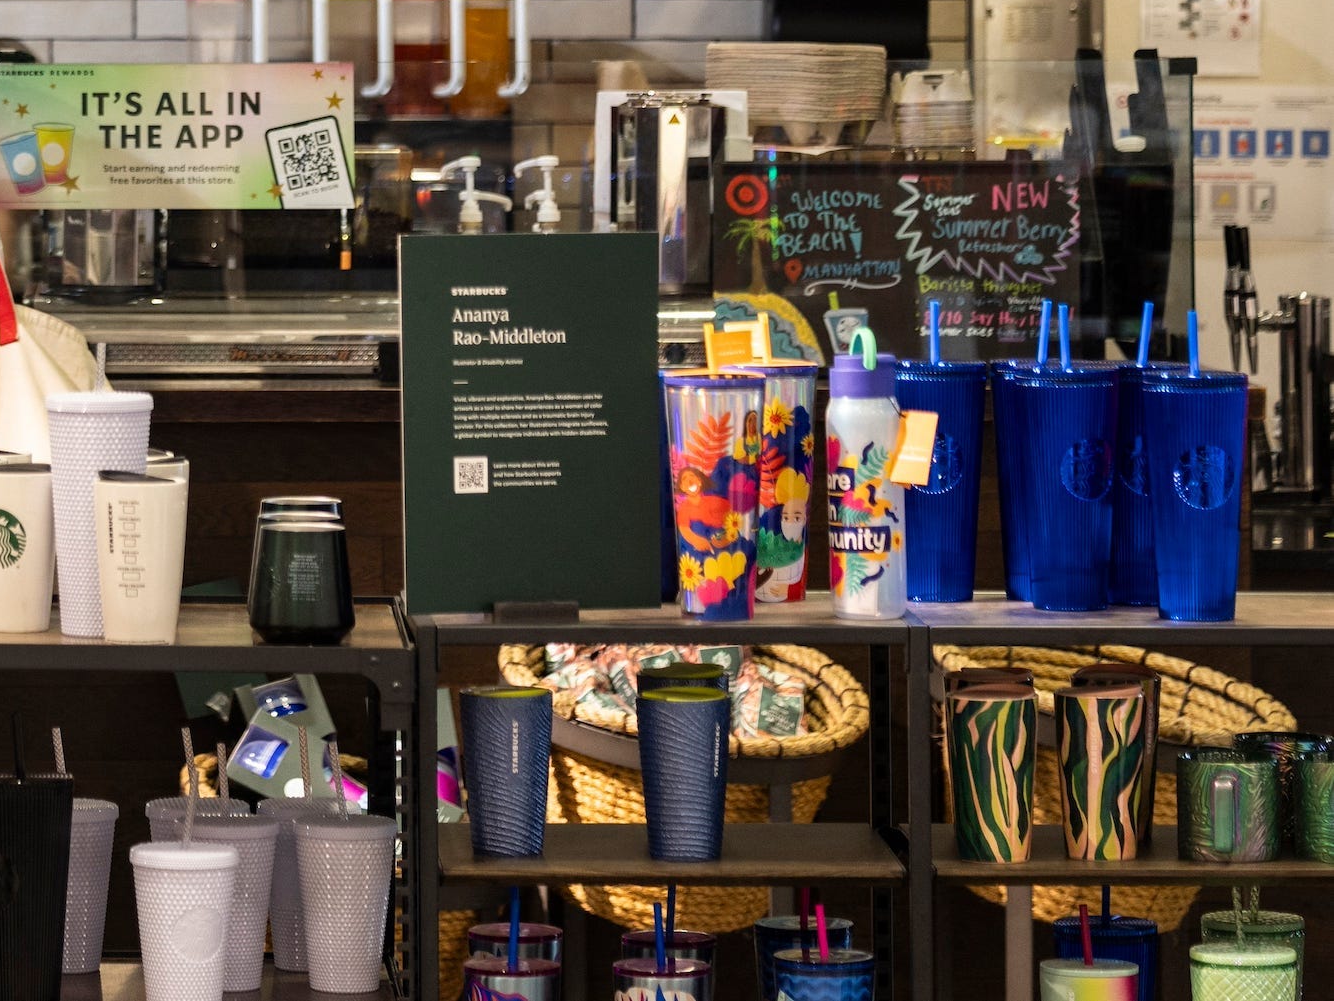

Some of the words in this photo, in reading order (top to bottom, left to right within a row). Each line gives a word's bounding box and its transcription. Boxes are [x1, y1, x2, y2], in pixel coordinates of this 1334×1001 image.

[81, 91, 143, 117] IT’S
[155, 91, 213, 117] ALL
[227, 91, 262, 117] IN
[98, 124, 163, 150] THE
[174, 124, 245, 150] APP
[103, 164, 127, 174] Start
[129, 165, 166, 176] earning
[167, 164, 186, 173] and
[187, 163, 240, 175] redeeming
[110, 176, 129, 185] free
[131, 176, 174, 185] favorites
[175, 177, 185, 185] at
[187, 176, 206, 185] this
[208, 177, 236, 185] store.
[790, 188, 883, 212] WELCOME
[991, 179, 1050, 213] NEW
[783, 212, 810, 230] TO
[931, 217, 1012, 240] Summer
[1016, 214, 1067, 244] Berry
[802, 259, 901, 280] MANHATTAN
[451, 287, 507, 296] STARBUCKS
[918, 274, 976, 295] Barista
[452, 308, 510, 325] Ananya
[452, 327, 567, 345] Rao-Middleton
[511, 719, 519, 775] STARBUCKS
[713, 721, 721, 778] STARBUCKS
